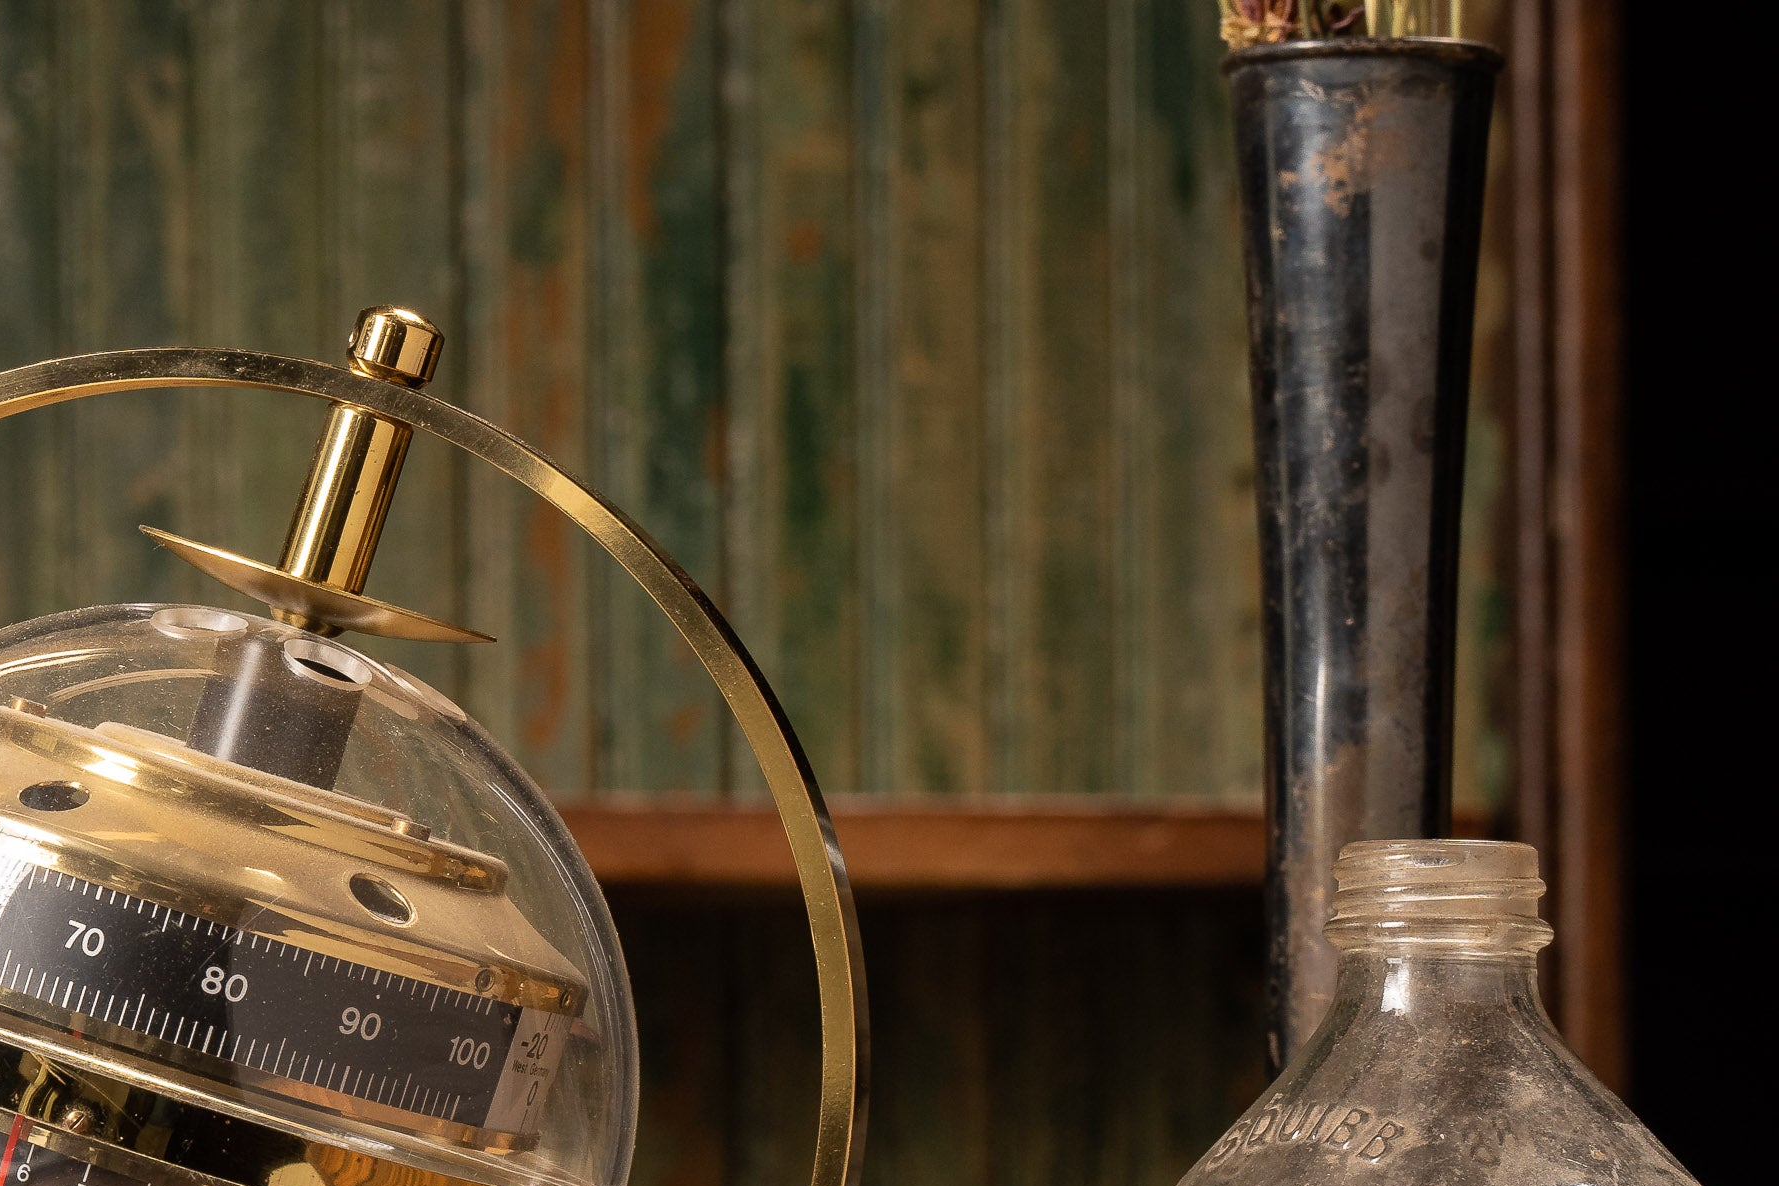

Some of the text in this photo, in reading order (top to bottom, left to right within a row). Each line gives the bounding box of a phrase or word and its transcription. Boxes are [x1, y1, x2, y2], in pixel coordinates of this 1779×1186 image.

[64, 919, 491, 1070] 70 80 90 100
[521, 1032, 548, 1059] -20
[512, 1060, 528, 1074] West
[526, 1081, 539, 1106] 0
[17, 1163, 31, 1182] 6
